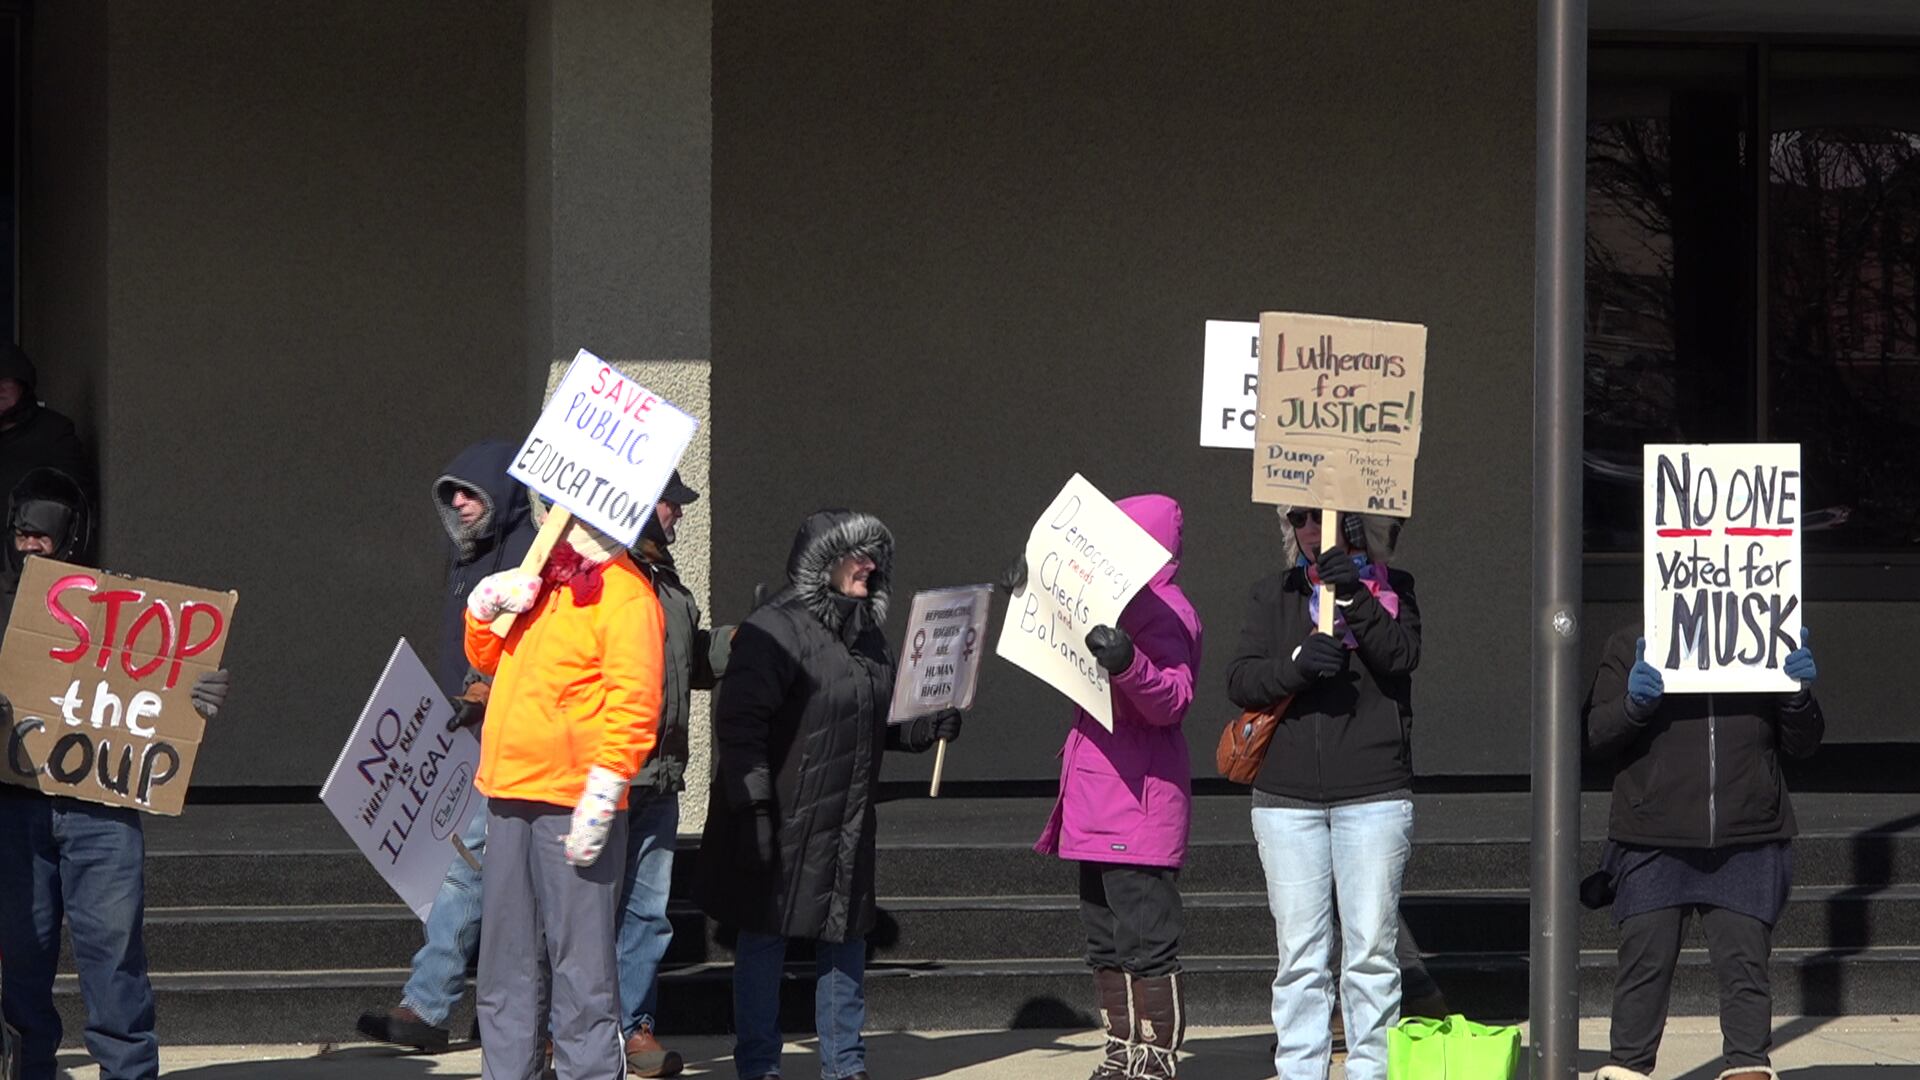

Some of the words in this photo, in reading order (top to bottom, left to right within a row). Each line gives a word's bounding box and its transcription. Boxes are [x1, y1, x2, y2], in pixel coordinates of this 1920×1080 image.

[1277, 333, 1406, 378] Lutherans
[591, 367, 657, 423] SAVE
[1311, 374, 1367, 398] for
[564, 392, 649, 465] PUBLIC
[1277, 391, 1415, 434] JUSTICE!
[1263, 465, 1315, 487] Trump
[1268, 445, 1325, 468] Dump
[1347, 448, 1391, 467] Protect
[1360, 466, 1379, 477] the
[517, 437, 649, 529] EDUCATION
[1366, 476, 1397, 489] rights
[1655, 452, 1718, 529] NO
[1726, 465, 1799, 528] ONE
[1051, 495, 1132, 600] Democracy
[1068, 557, 1095, 584] needs
[1739, 541, 1792, 589] for
[1040, 551, 1090, 624] Checks
[45, 574, 223, 690] STOP
[1020, 592, 1104, 692] Balances
[1057, 611, 1073, 630] and
[1665, 588, 1798, 671] MUSK
[920, 682, 953, 697] RIGHTS
[925, 663, 954, 678] HUMAN
[50, 679, 162, 737] the
[399, 696, 432, 753] BEING
[357, 708, 401, 785] NO
[399, 761, 413, 787] IS
[378, 733, 454, 865] ILLEGAL
